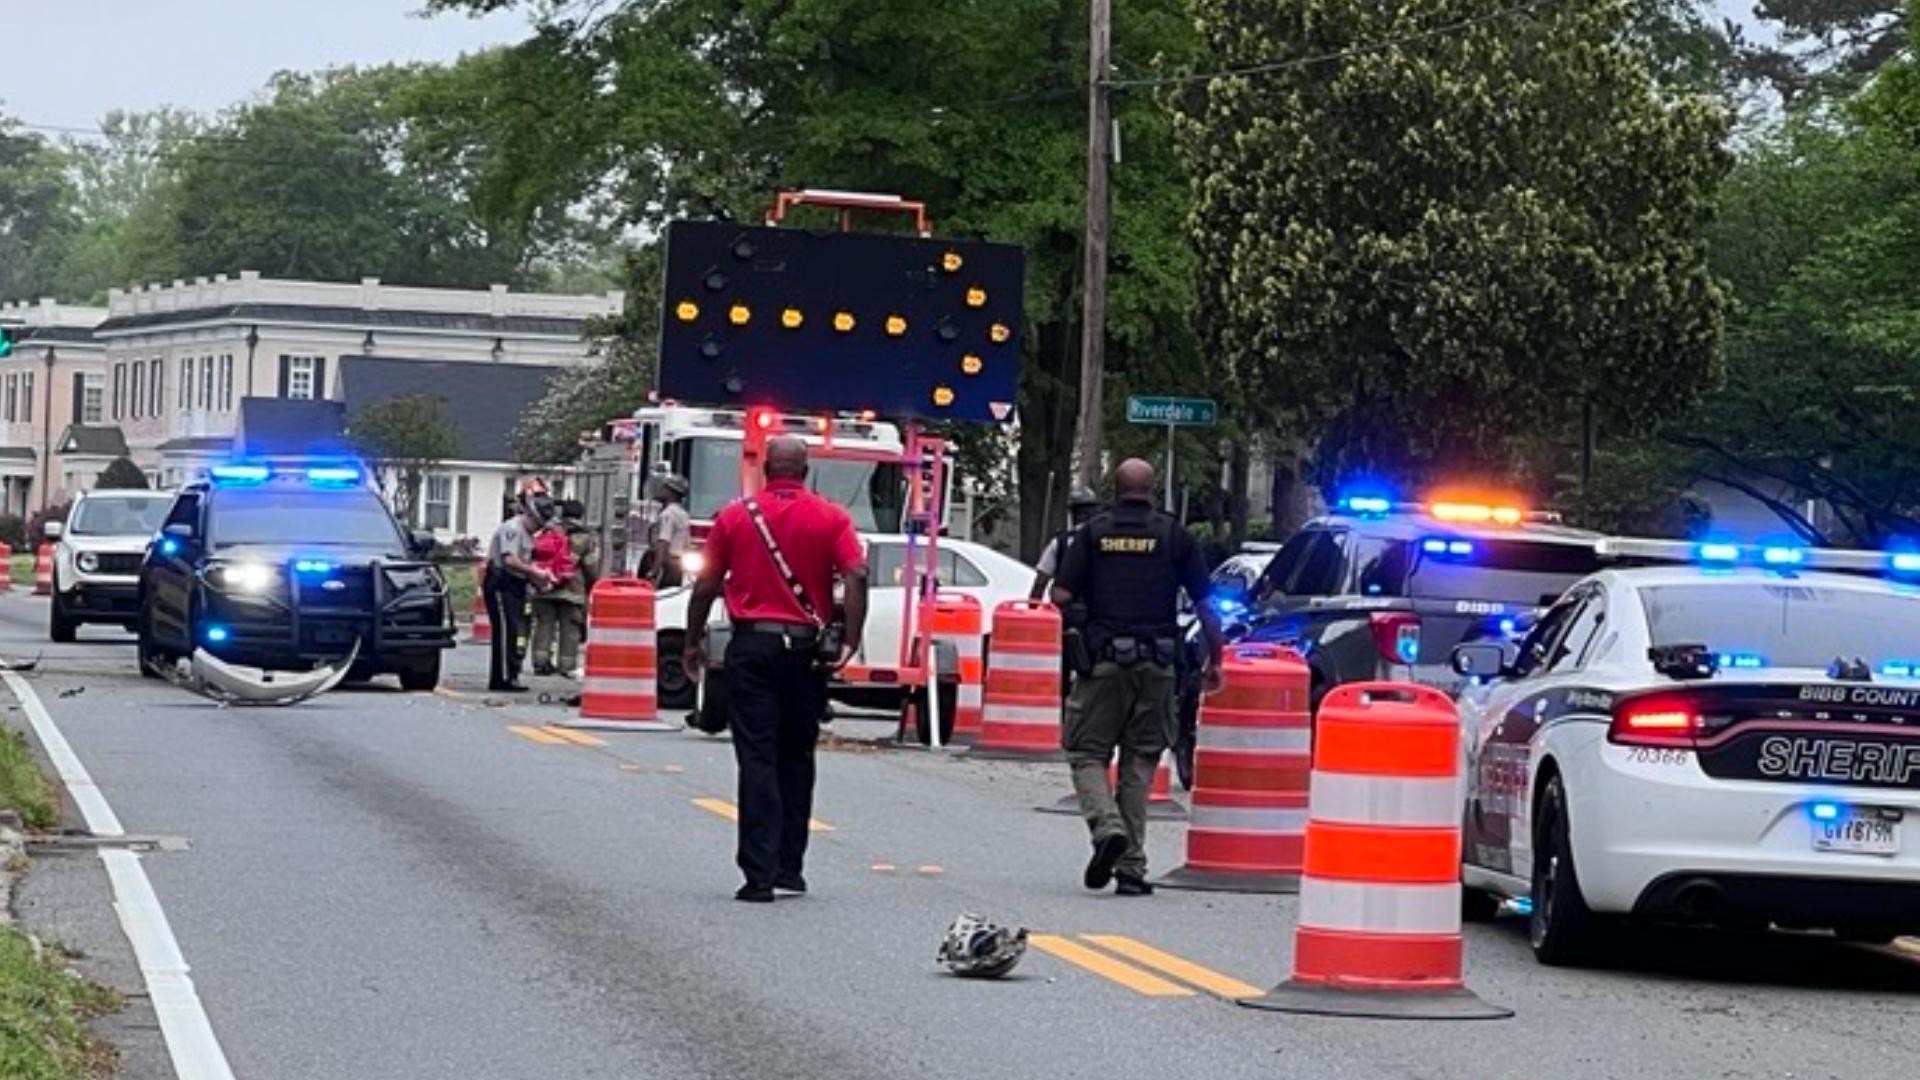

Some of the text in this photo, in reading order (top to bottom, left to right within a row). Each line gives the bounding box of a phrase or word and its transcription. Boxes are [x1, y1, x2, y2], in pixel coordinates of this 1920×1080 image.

[1131, 401, 1194, 420] Riverdale
[1100, 537, 1157, 553] SHERIFF
[1799, 686, 1847, 702] BIBB
[1626, 748, 1688, 765] 70366
